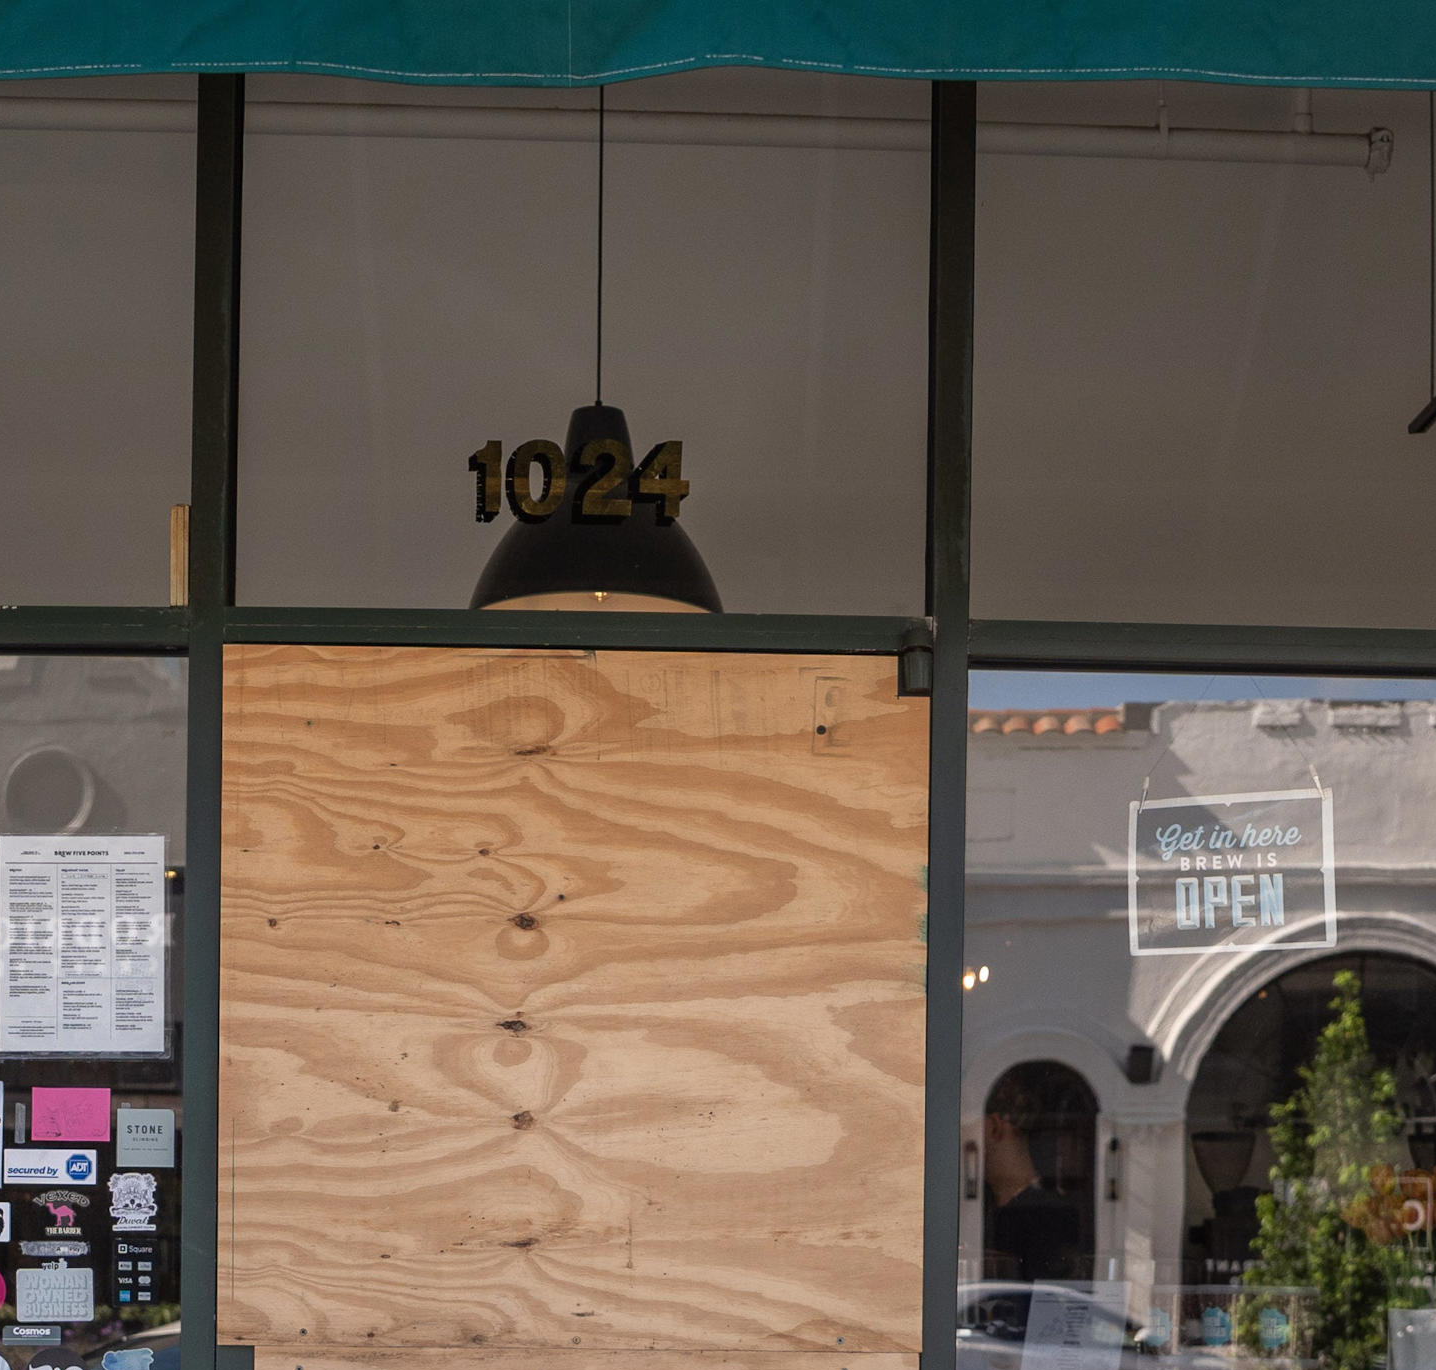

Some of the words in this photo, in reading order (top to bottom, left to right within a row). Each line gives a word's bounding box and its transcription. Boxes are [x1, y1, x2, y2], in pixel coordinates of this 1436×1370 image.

[468, 438, 690, 527] 1024
[1155, 824, 1205, 862] Get
[1208, 826, 1236, 849] in
[1239, 823, 1302, 848] here
[1180, 854, 1243, 871] BREW
[1257, 852, 1278, 868] IS
[1175, 873, 1285, 930] OPEN
[126, 1124, 164, 1135] STONE
[7, 1166, 46, 1175] secured
[47, 1166, 59, 1176] by
[70, 1162, 89, 1172] ADT
[128, 1245, 153, 1255] Square
[42, 1262, 59, 1270] yelp
[24, 1272, 88, 1289] WOMAN
[25, 1289, 88, 1303] OWNED
[24, 1303, 89, 1317] BUSINESS
[13, 1326, 51, 1335] Cosmos
